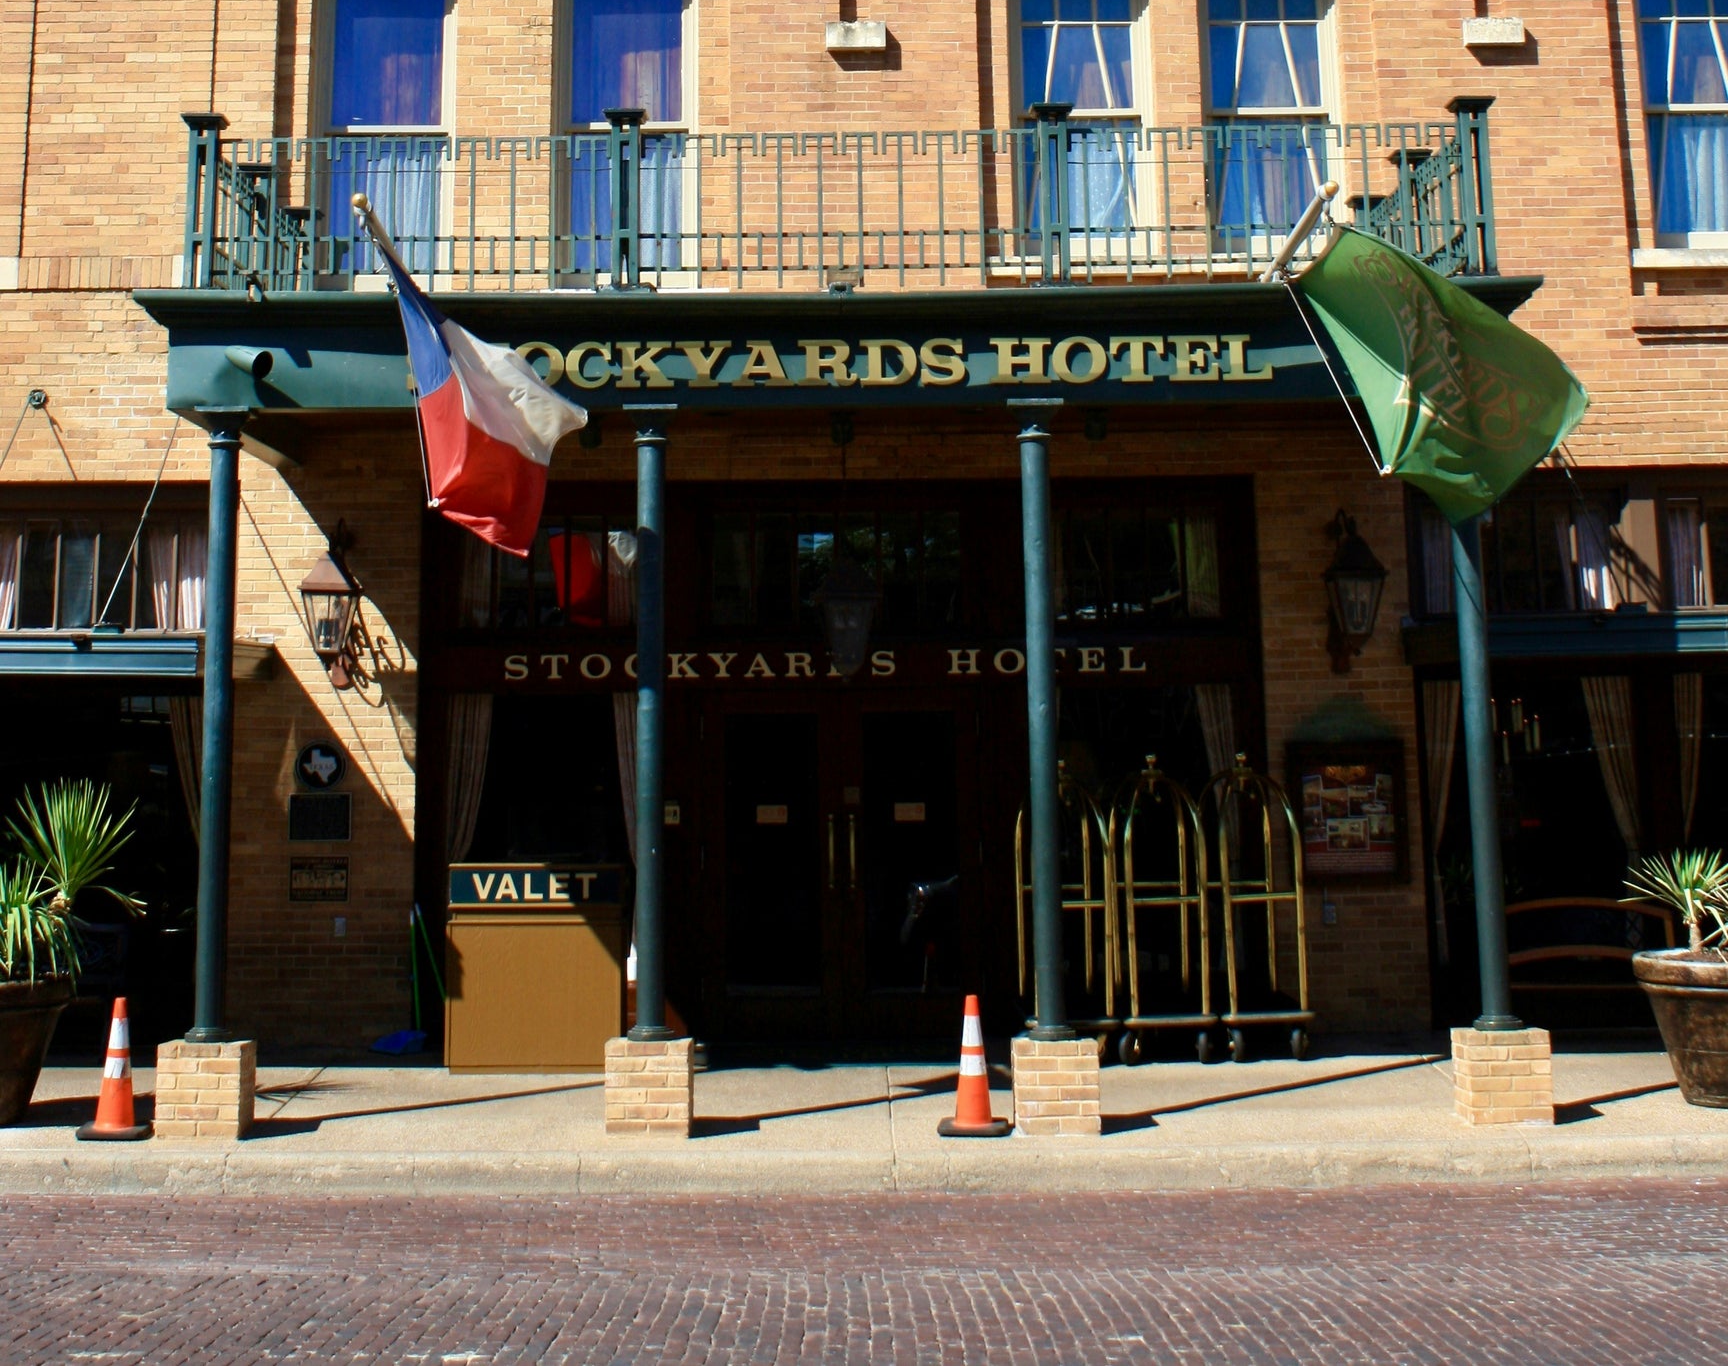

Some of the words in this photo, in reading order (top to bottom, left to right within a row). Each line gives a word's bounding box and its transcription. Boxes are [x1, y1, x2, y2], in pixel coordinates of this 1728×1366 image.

[406, 337, 969, 389] OCKYARDS
[990, 335, 1273, 384] HOTEL
[473, 873, 597, 900] VALET
